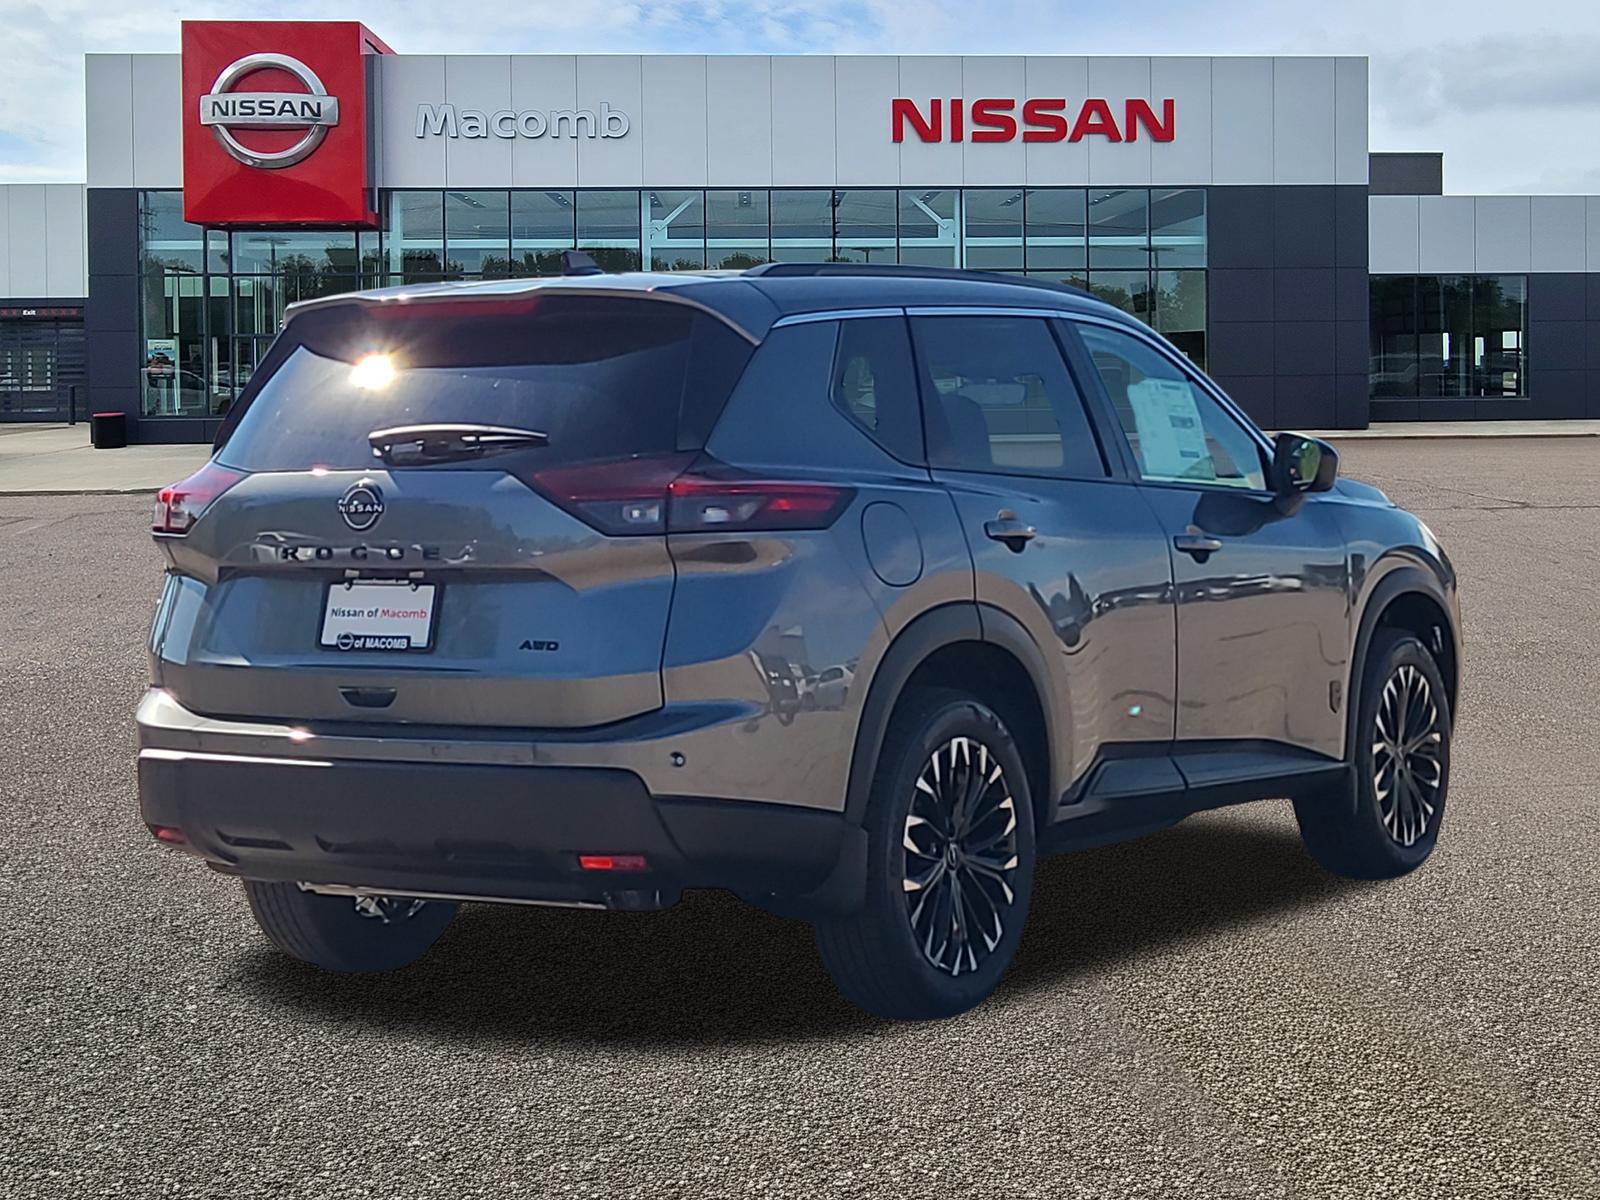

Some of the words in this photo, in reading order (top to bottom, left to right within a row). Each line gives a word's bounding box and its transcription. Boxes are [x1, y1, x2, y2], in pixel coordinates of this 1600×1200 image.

[211, 100, 322, 117] NISSAN
[415, 102, 630, 139] Macomb
[892, 98, 1175, 143] NISSAN
[338, 504, 383, 513] NISSAN
[281, 546, 440, 561] ROGUE
[330, 607, 365, 618] Nissan
[367, 607, 379, 618] of
[380, 608, 427, 619] Macomb
[354, 638, 364, 649] of
[365, 638, 408, 649] MACOMB
[519, 639, 560, 651] AWD
